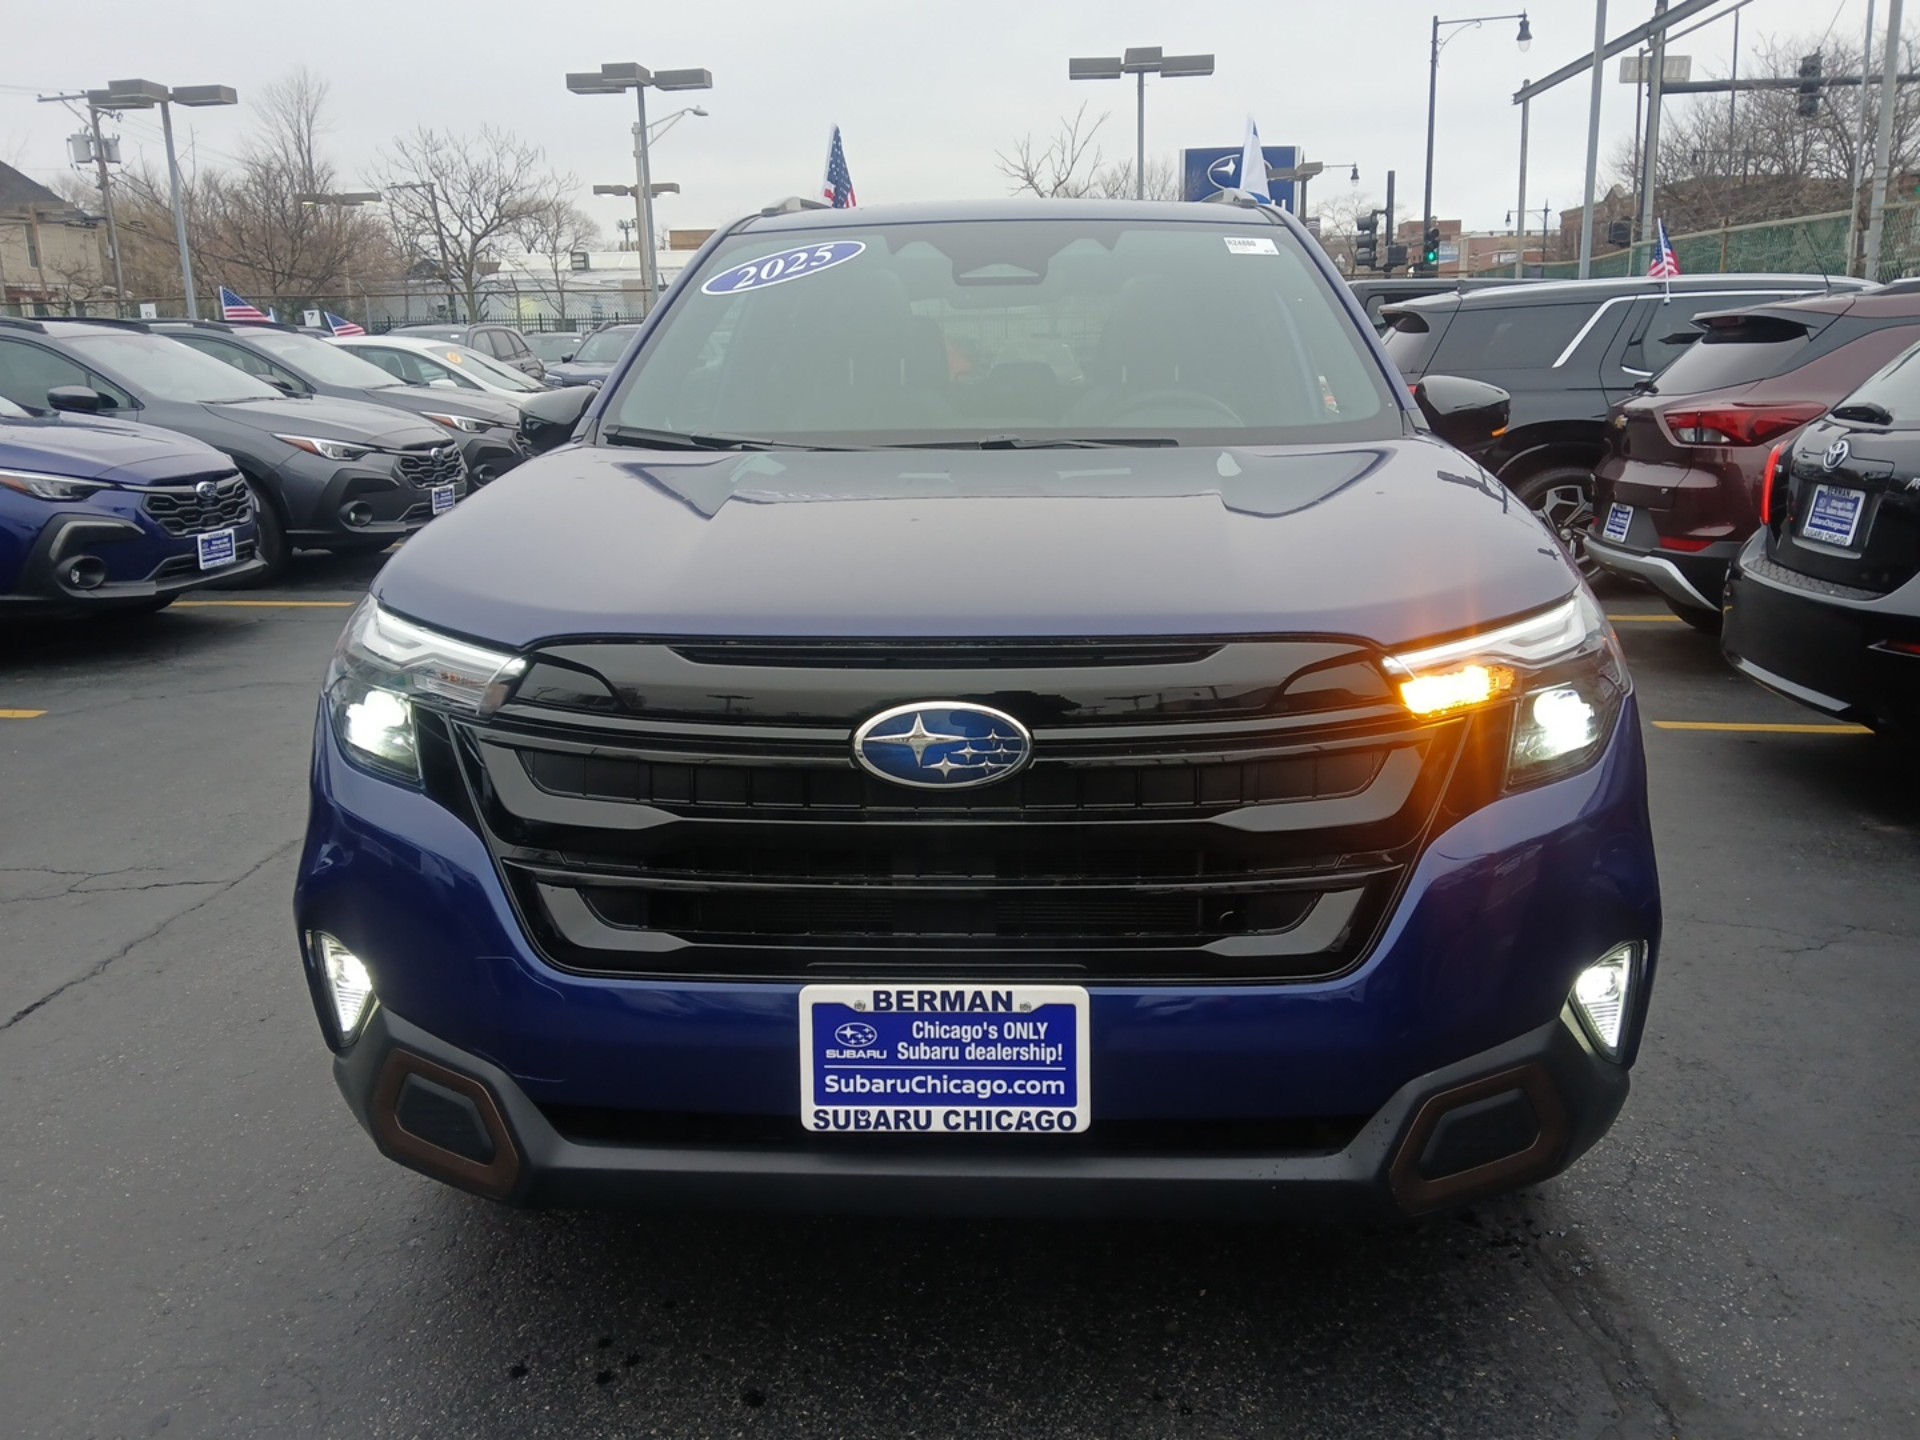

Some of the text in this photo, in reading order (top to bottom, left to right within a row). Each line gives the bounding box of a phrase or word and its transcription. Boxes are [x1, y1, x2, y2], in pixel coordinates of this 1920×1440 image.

[733, 244, 835, 291] 2025
[873, 990, 1013, 1012] BERMAN
[912, 1021, 1048, 1043] Chicago's ONLY
[825, 1049, 887, 1059] SUBARU
[897, 1042, 1063, 1065] Subaru dealership!
[825, 1074, 1065, 1099] SubaruChicago.com
[813, 1108, 1077, 1131] SUBARU CHICAGO
